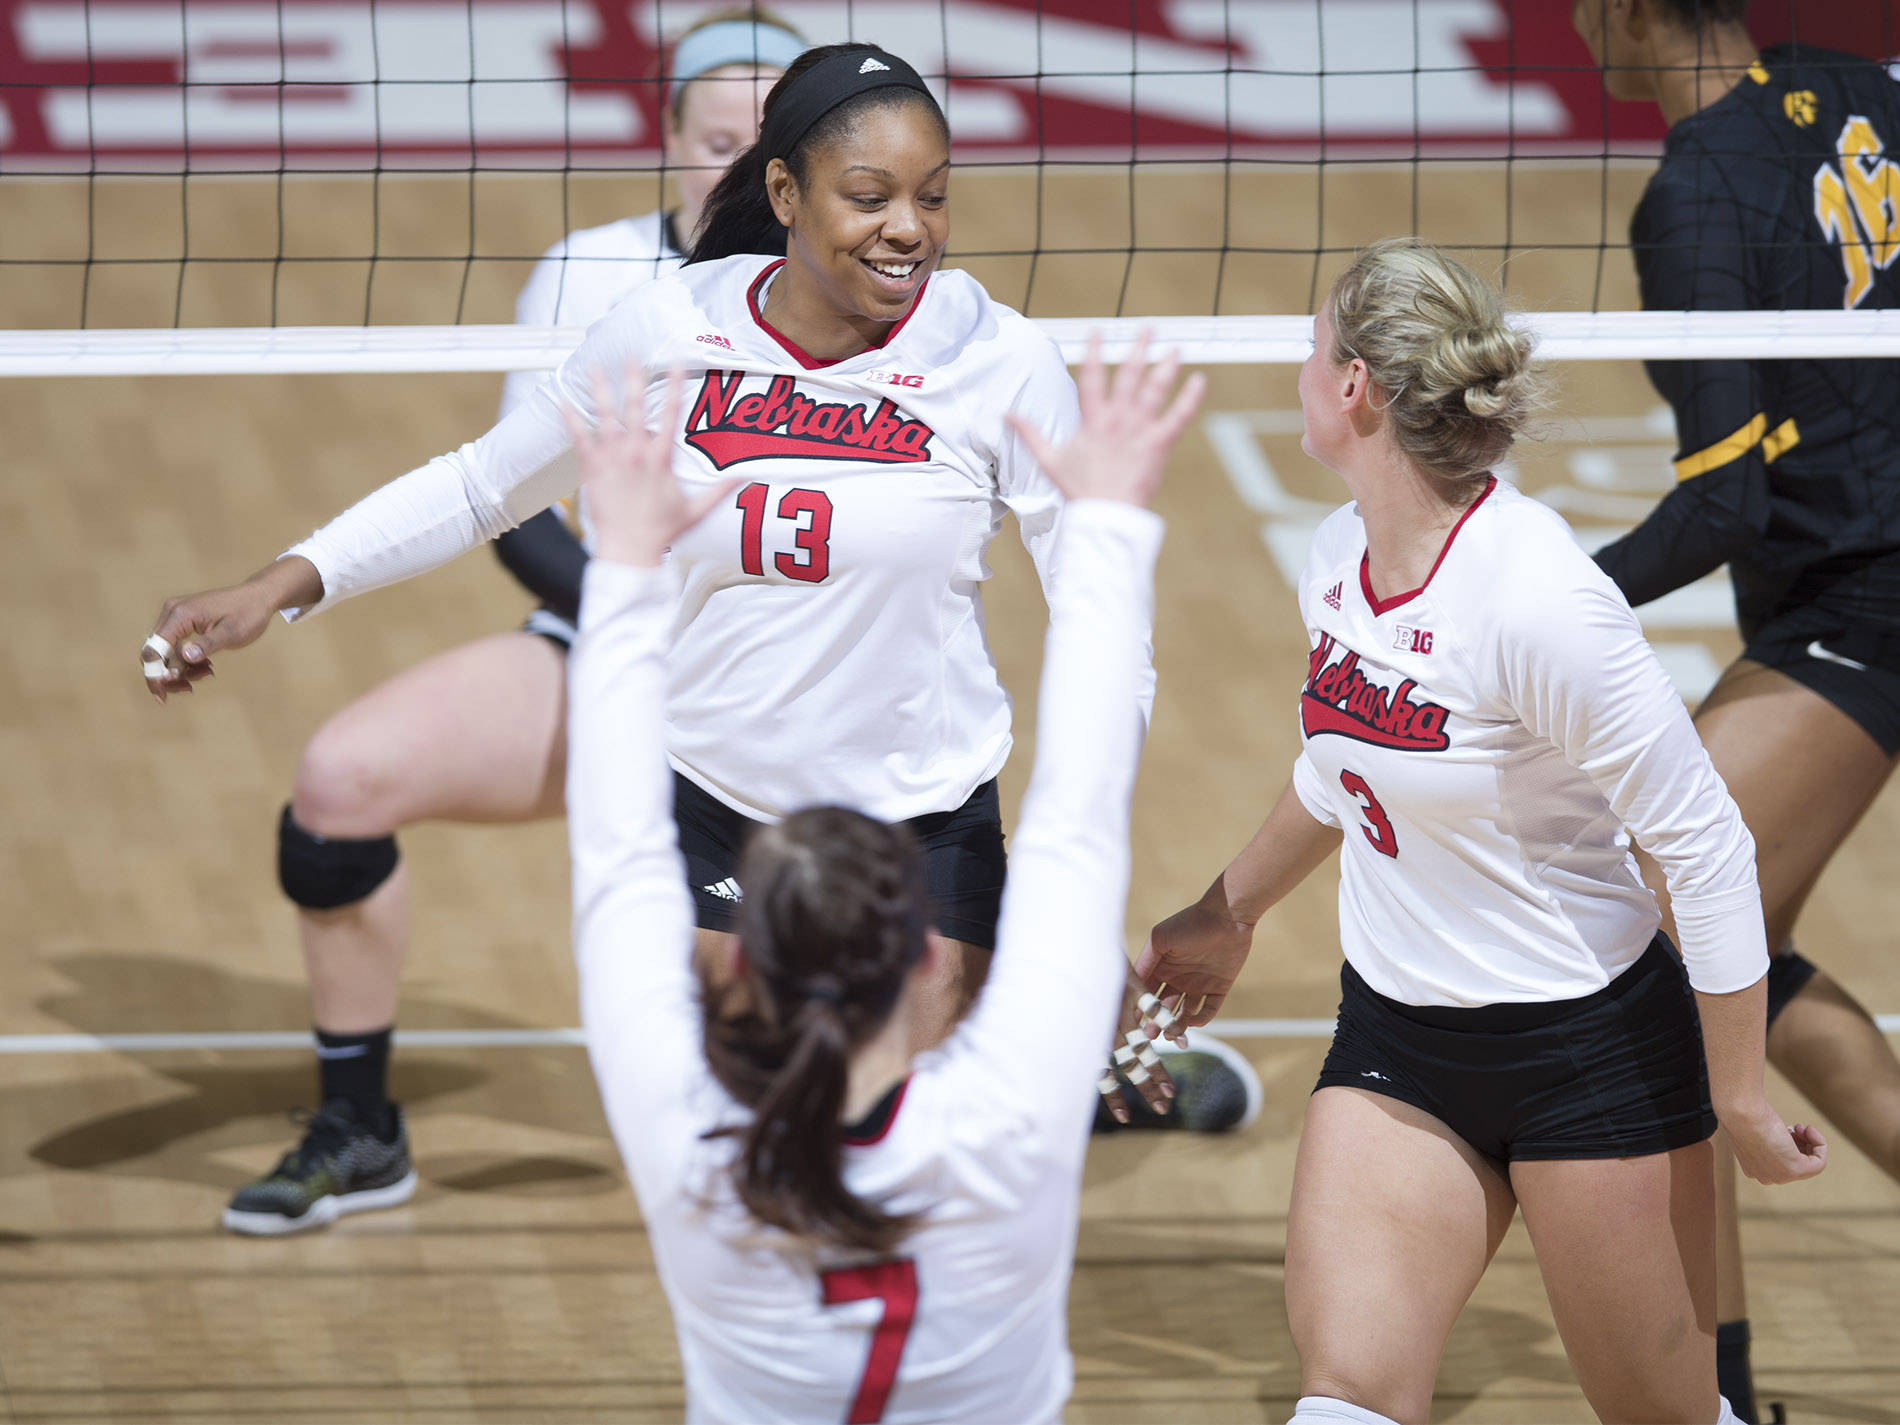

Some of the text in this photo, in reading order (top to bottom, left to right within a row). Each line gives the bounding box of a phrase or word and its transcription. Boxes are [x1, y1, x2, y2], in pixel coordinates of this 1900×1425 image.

[684, 368, 935, 464] Nebraska
[736, 481, 834, 584] 13
[1301, 630, 1451, 750] Nebraska
[1340, 768, 1399, 859] 3
[819, 1256, 920, 1425] 7
